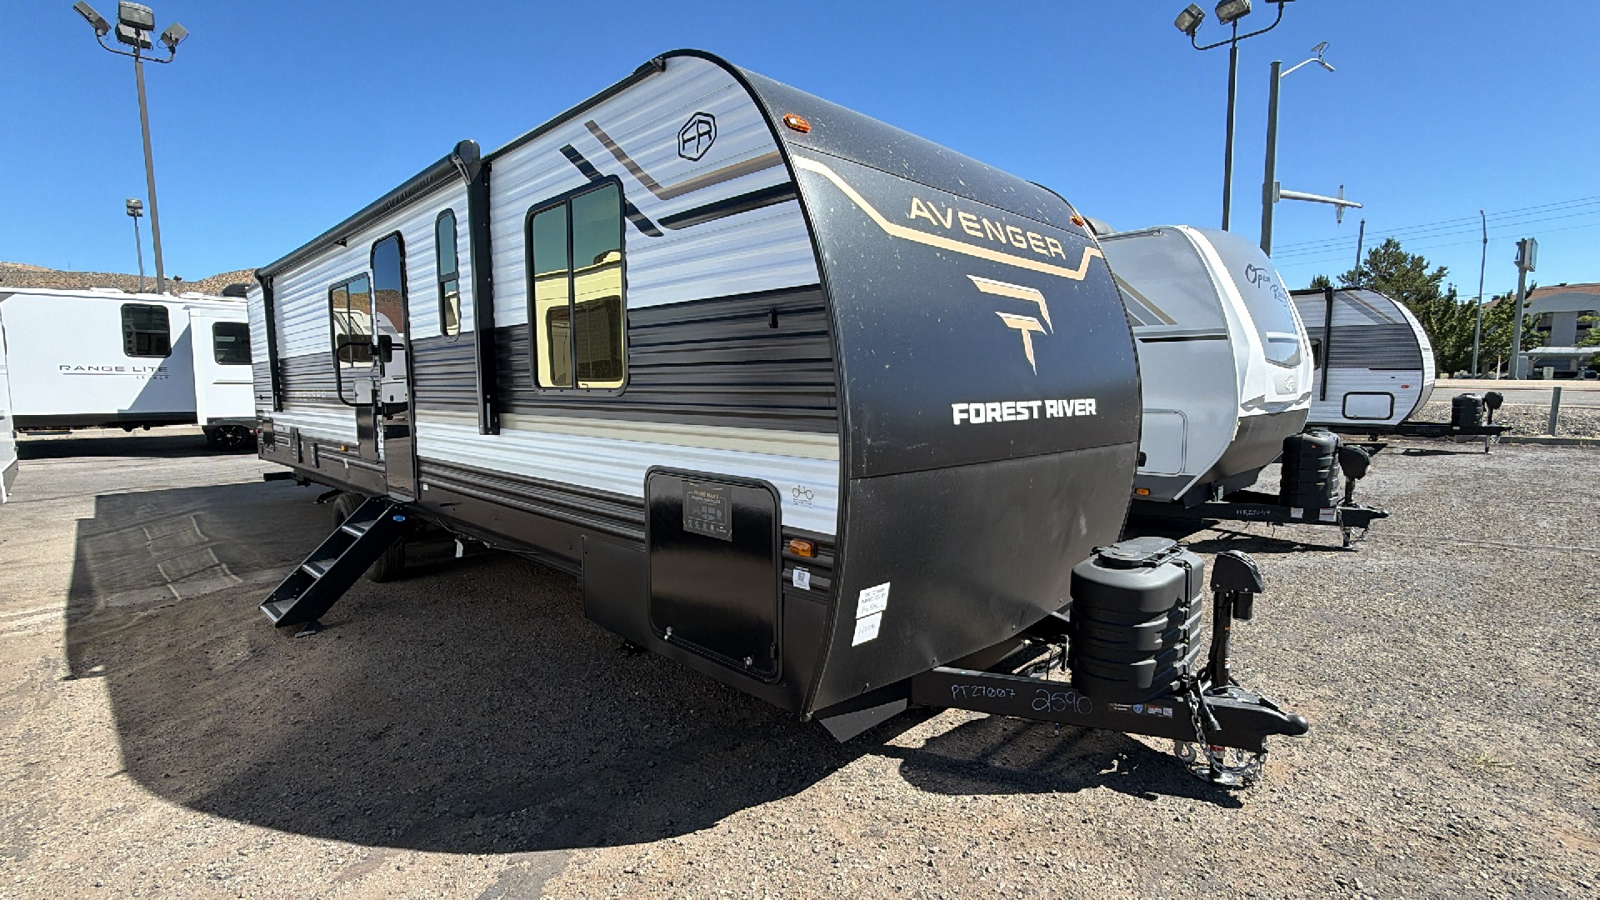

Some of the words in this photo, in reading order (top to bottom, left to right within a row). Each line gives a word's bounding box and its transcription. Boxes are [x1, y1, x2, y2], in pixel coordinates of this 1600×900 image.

[910, 197, 1066, 260] AVENGER
[1245, 263, 1271, 289] Open
[951, 401, 1043, 425] FOREST
[1044, 398, 1097, 419] RIVER
[951, 684, 1016, 700] PT27007
[1031, 688, 1093, 715] 2590
